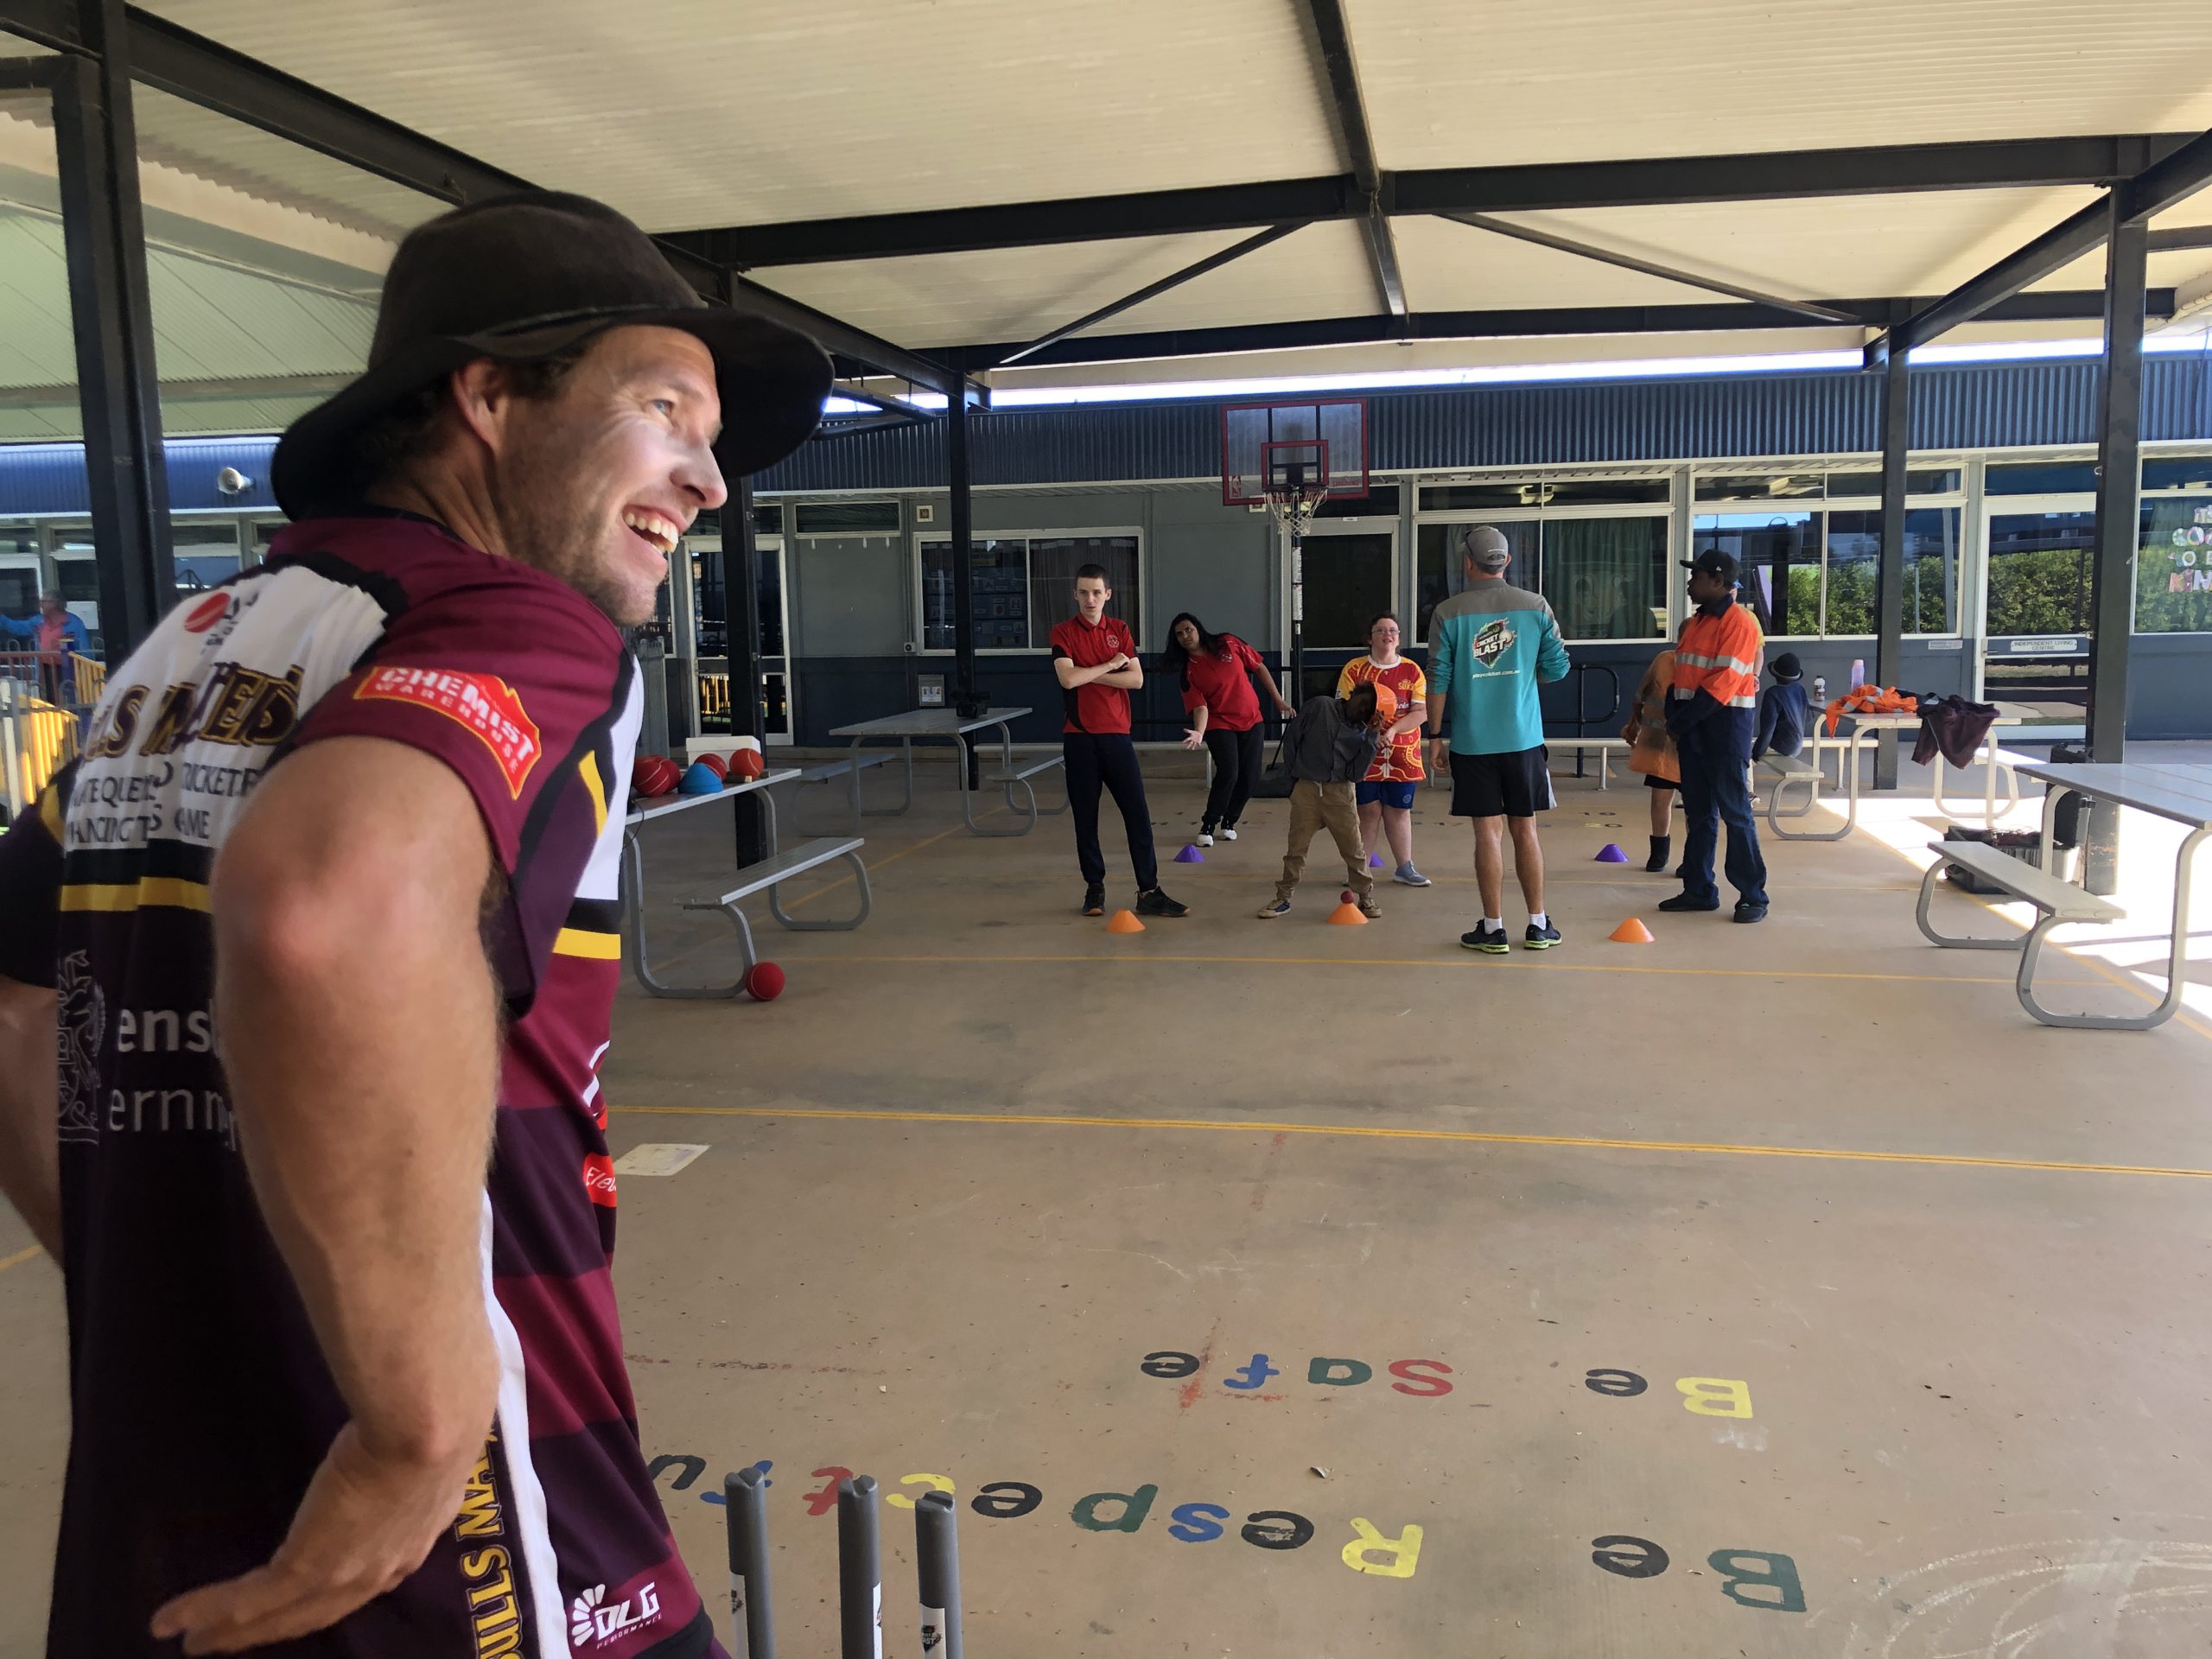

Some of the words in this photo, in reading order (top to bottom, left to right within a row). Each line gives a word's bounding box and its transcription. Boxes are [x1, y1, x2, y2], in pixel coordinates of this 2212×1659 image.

[2169, 569, 2212, 593] KIN
[1474, 639, 1507, 657] BLAST
[375, 683, 518, 774] WAREHOUSE
[381, 668, 535, 762] CHEMIST
[1141, 1351, 1453, 1397] Safe
[1585, 1368, 1753, 1419] Be
[1592, 1535, 1807, 1612] Be
